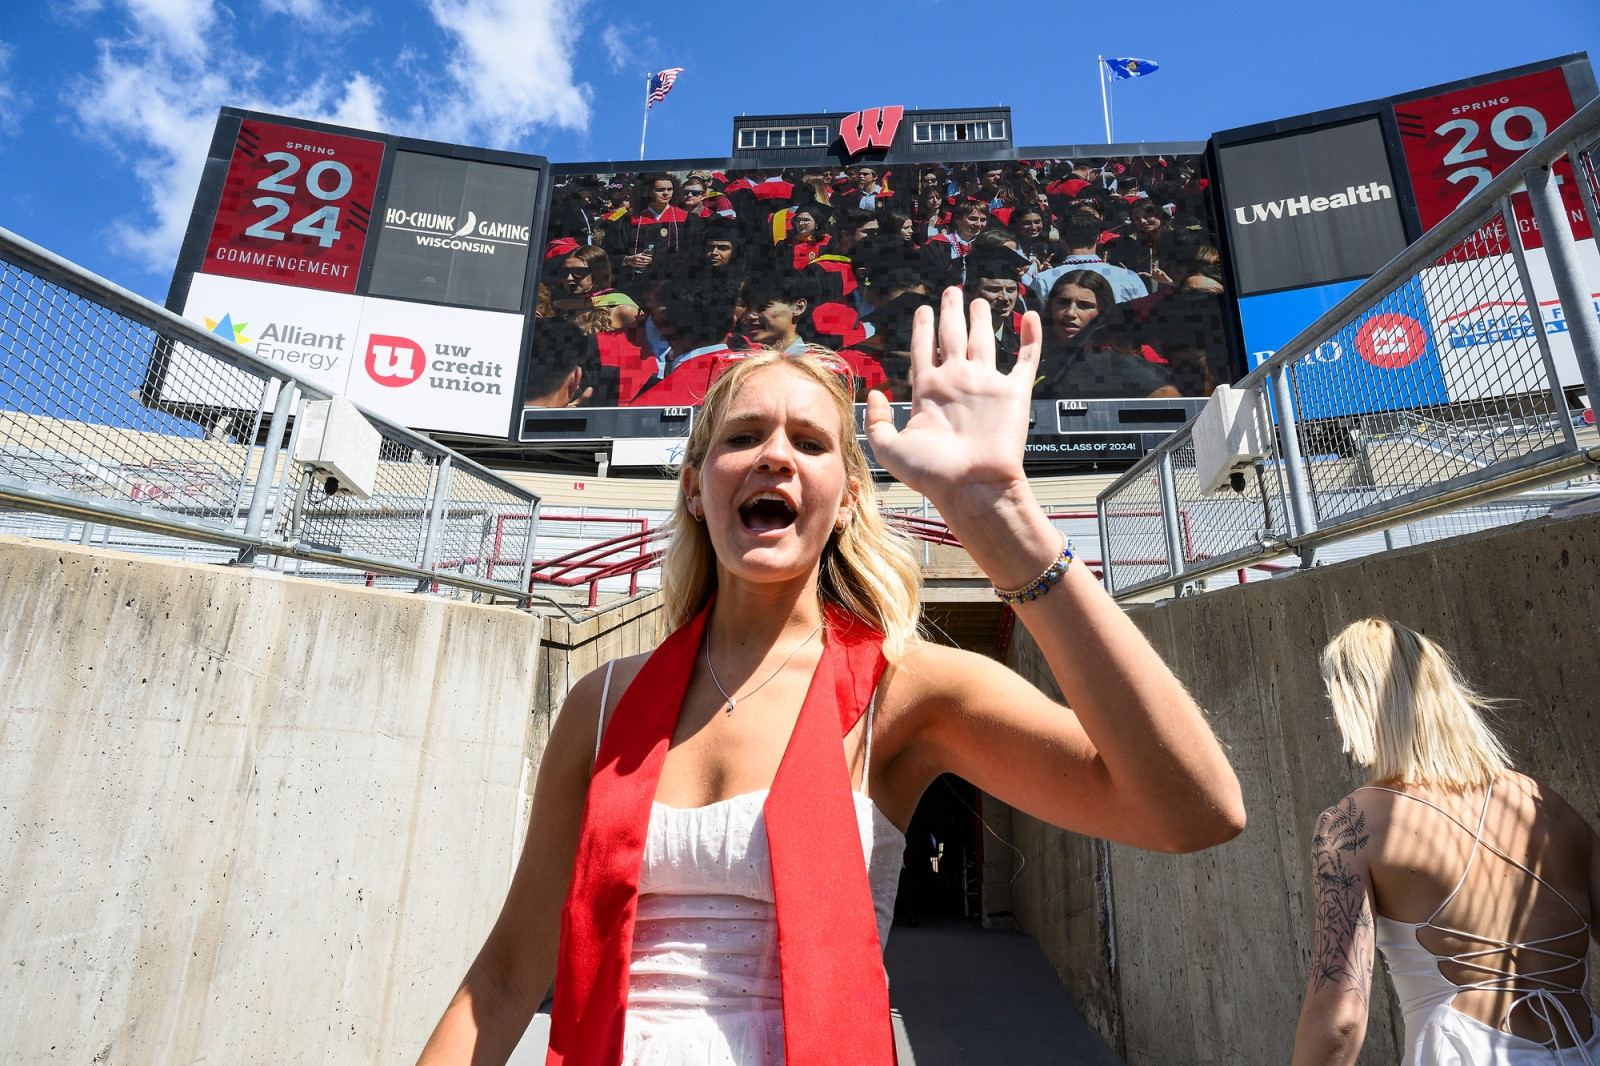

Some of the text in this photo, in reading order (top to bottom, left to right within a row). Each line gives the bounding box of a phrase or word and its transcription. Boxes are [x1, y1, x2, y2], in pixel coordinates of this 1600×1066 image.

[1451, 96, 1510, 115] SPRING
[839, 105, 904, 158] W
[1434, 106, 1547, 166] 20
[286, 141, 336, 156] SPRING
[256, 151, 353, 201] 20
[244, 196, 342, 248] 24
[385, 208, 530, 241] HO-CHUNK GAMING
[416, 235, 496, 255] WISCONSIN
[216, 247, 350, 279] COMMENCEMENT
[1449, 310, 1545, 337] AMERICA
[258, 322, 346, 351] Alliant
[255, 342, 340, 371] Energy
[434, 342, 472, 358] uw
[431, 358, 503, 379] credit
[429, 375, 502, 396] union
[664, 407, 687, 417] T.O.L.
[1062, 401, 1088, 411] T.O.L.
[1059, 443, 1092, 452] CLASS
[1093, 443, 1108, 451] OF
[1109, 442, 1137, 451] 2024!
